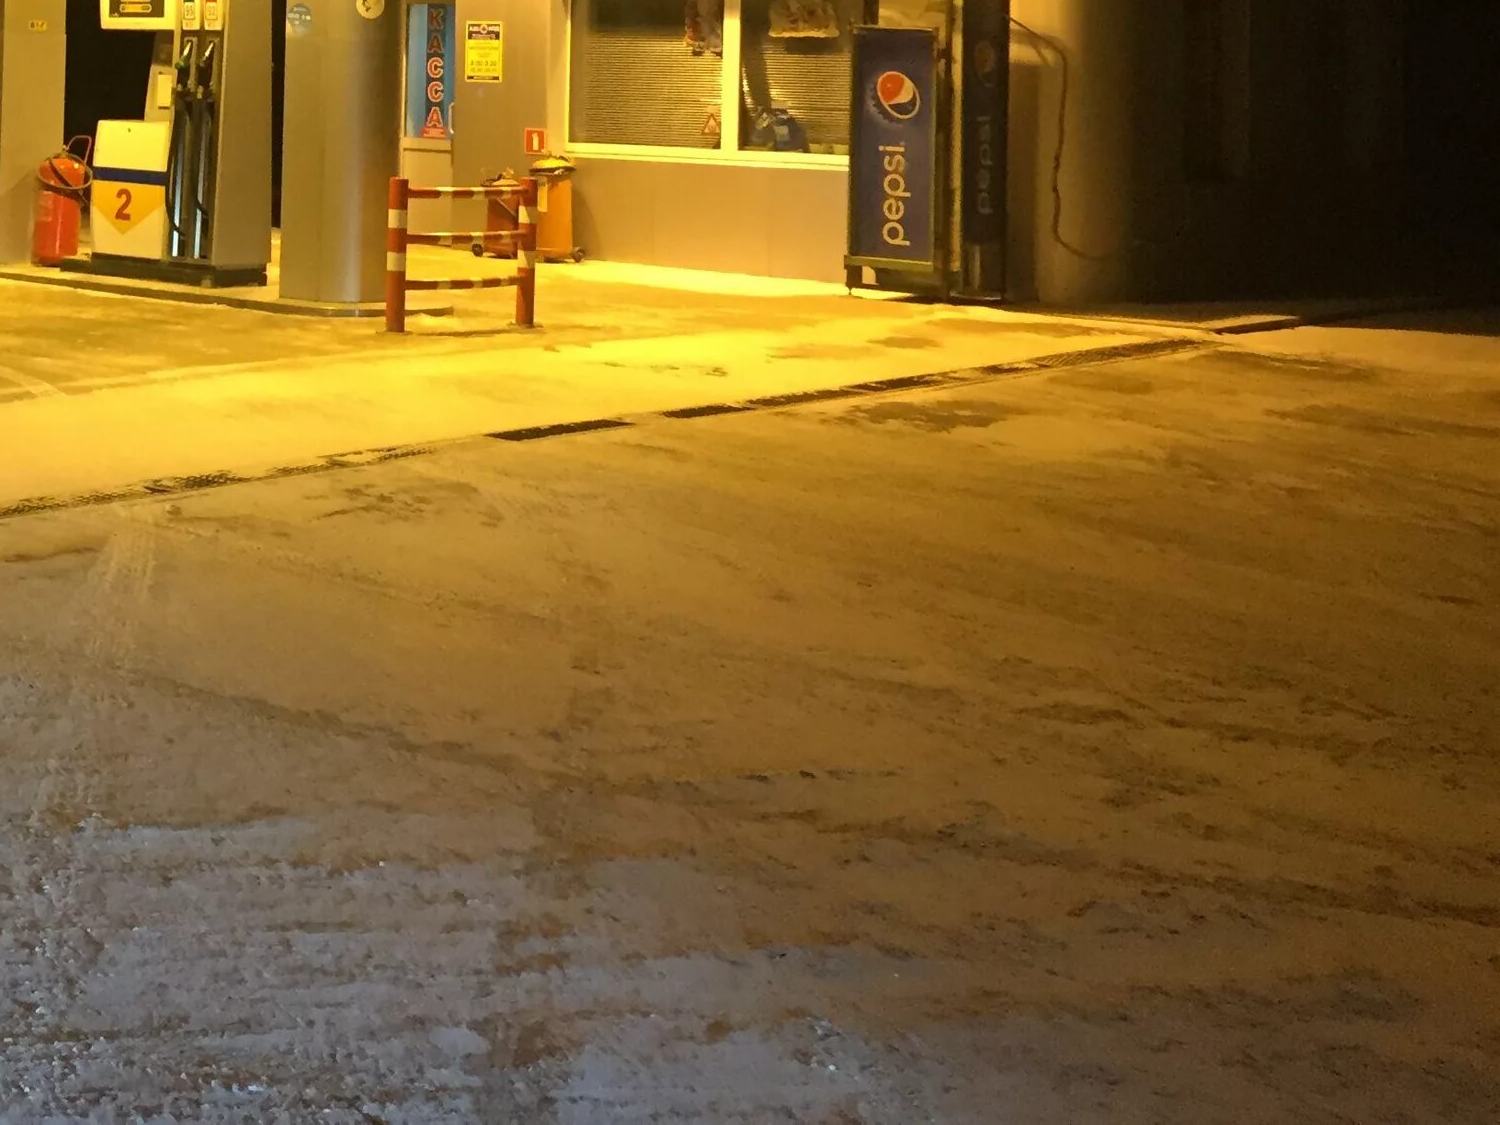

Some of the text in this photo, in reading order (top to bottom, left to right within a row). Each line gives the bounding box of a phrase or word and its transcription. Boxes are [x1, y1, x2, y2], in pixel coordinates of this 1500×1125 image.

[427, 8, 444, 127] КАССА
[115, 188, 132, 222] 2
[878, 143, 911, 246] pepsi
